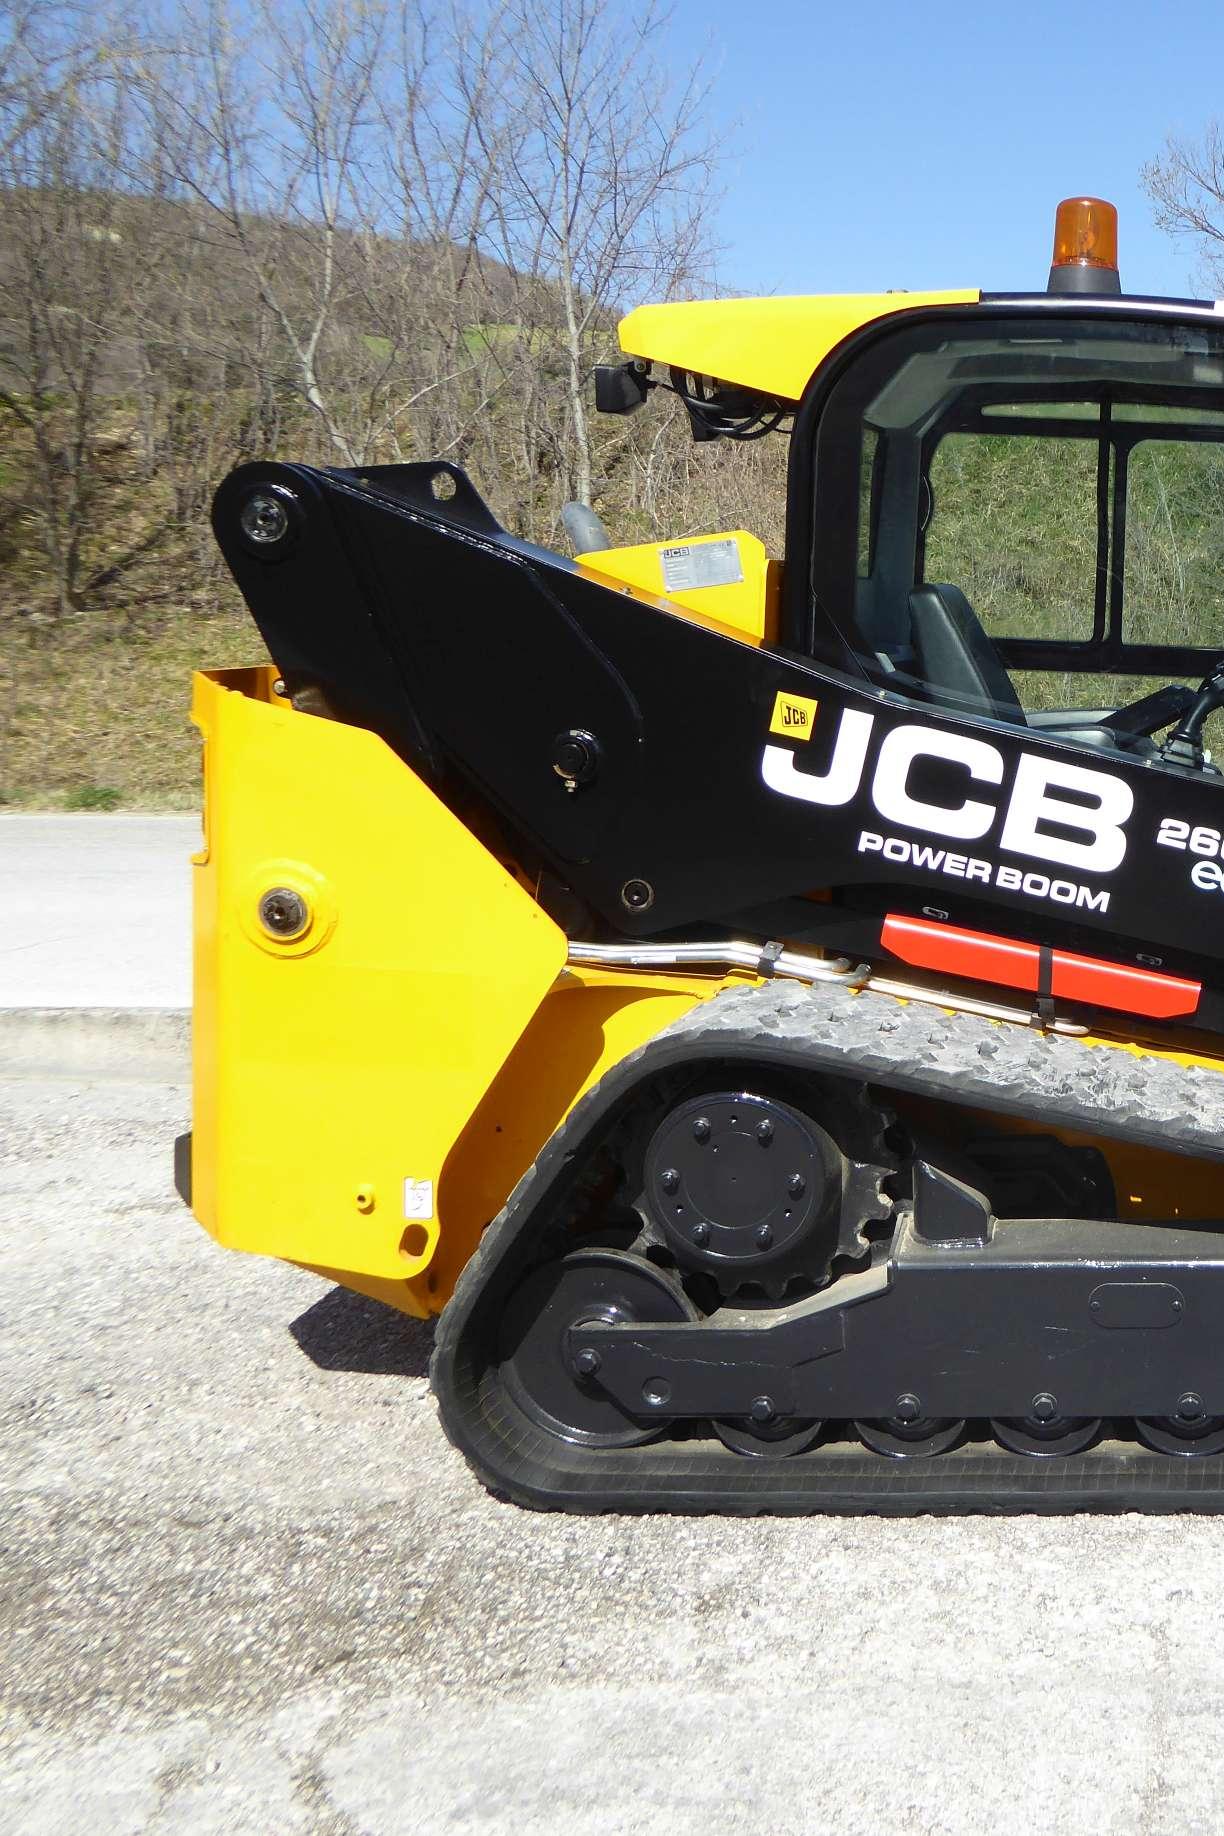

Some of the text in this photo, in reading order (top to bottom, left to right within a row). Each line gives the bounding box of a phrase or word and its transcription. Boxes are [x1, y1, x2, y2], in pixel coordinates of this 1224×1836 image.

[664, 547, 690, 558] JCB
[783, 705, 806, 725] JCB
[761, 707, 1135, 873] JCB
[857, 831, 1111, 913] POWER BOOM
